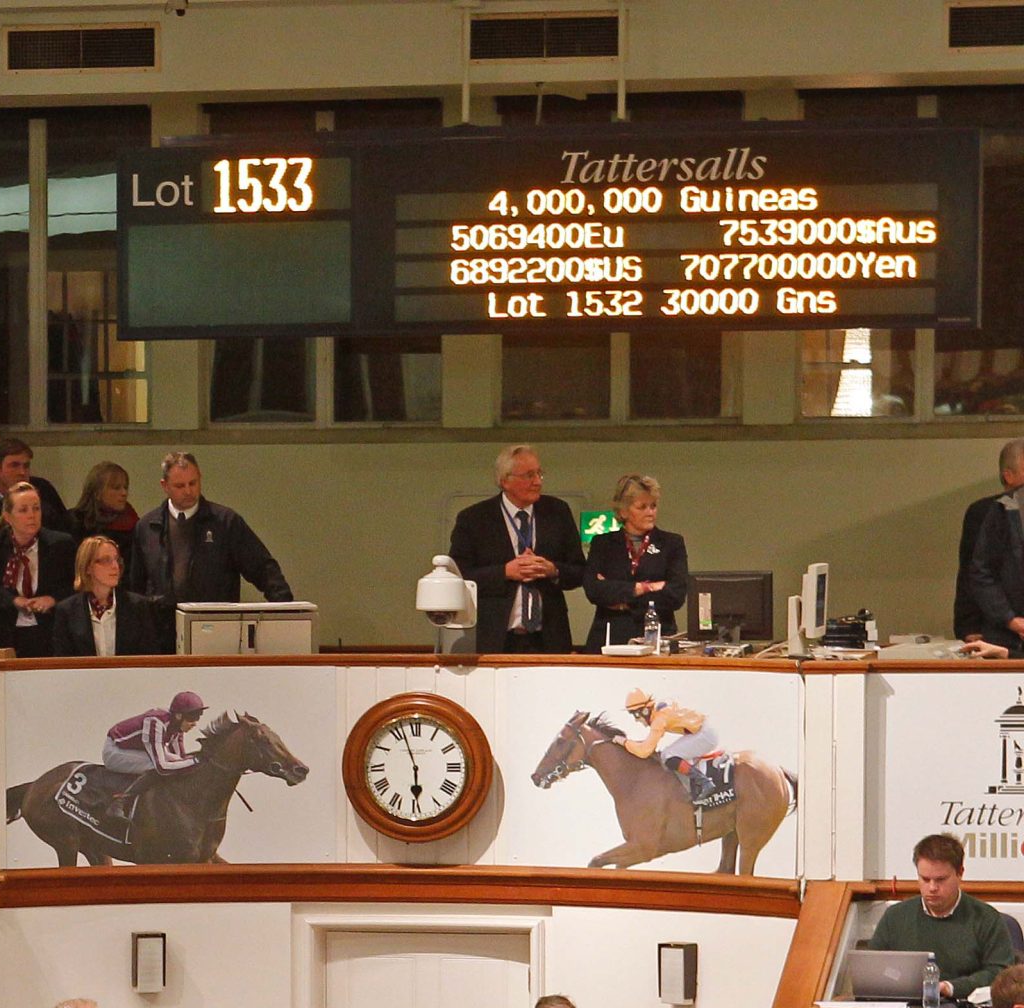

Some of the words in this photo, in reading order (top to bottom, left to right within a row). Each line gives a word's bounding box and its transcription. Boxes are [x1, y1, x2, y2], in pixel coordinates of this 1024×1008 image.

[560, 148, 768, 184] Tattersalls
[132, 174, 194, 207] Lot
[213, 157, 313, 213] 1533
[680, 186, 818, 213] Guineas
[450, 222, 625, 251] 5069400Eu
[719, 217, 937, 246] 7539000$Aus
[450, 256, 643, 285] 6892200$US
[680, 251, 918, 281] 707700000Yen
[488, 292, 547, 318] Lot
[566, 290, 643, 317] 1532
[661, 288, 760, 316] 30000
[776, 287, 837, 314] Gns
[66, 772, 87, 795] 3
